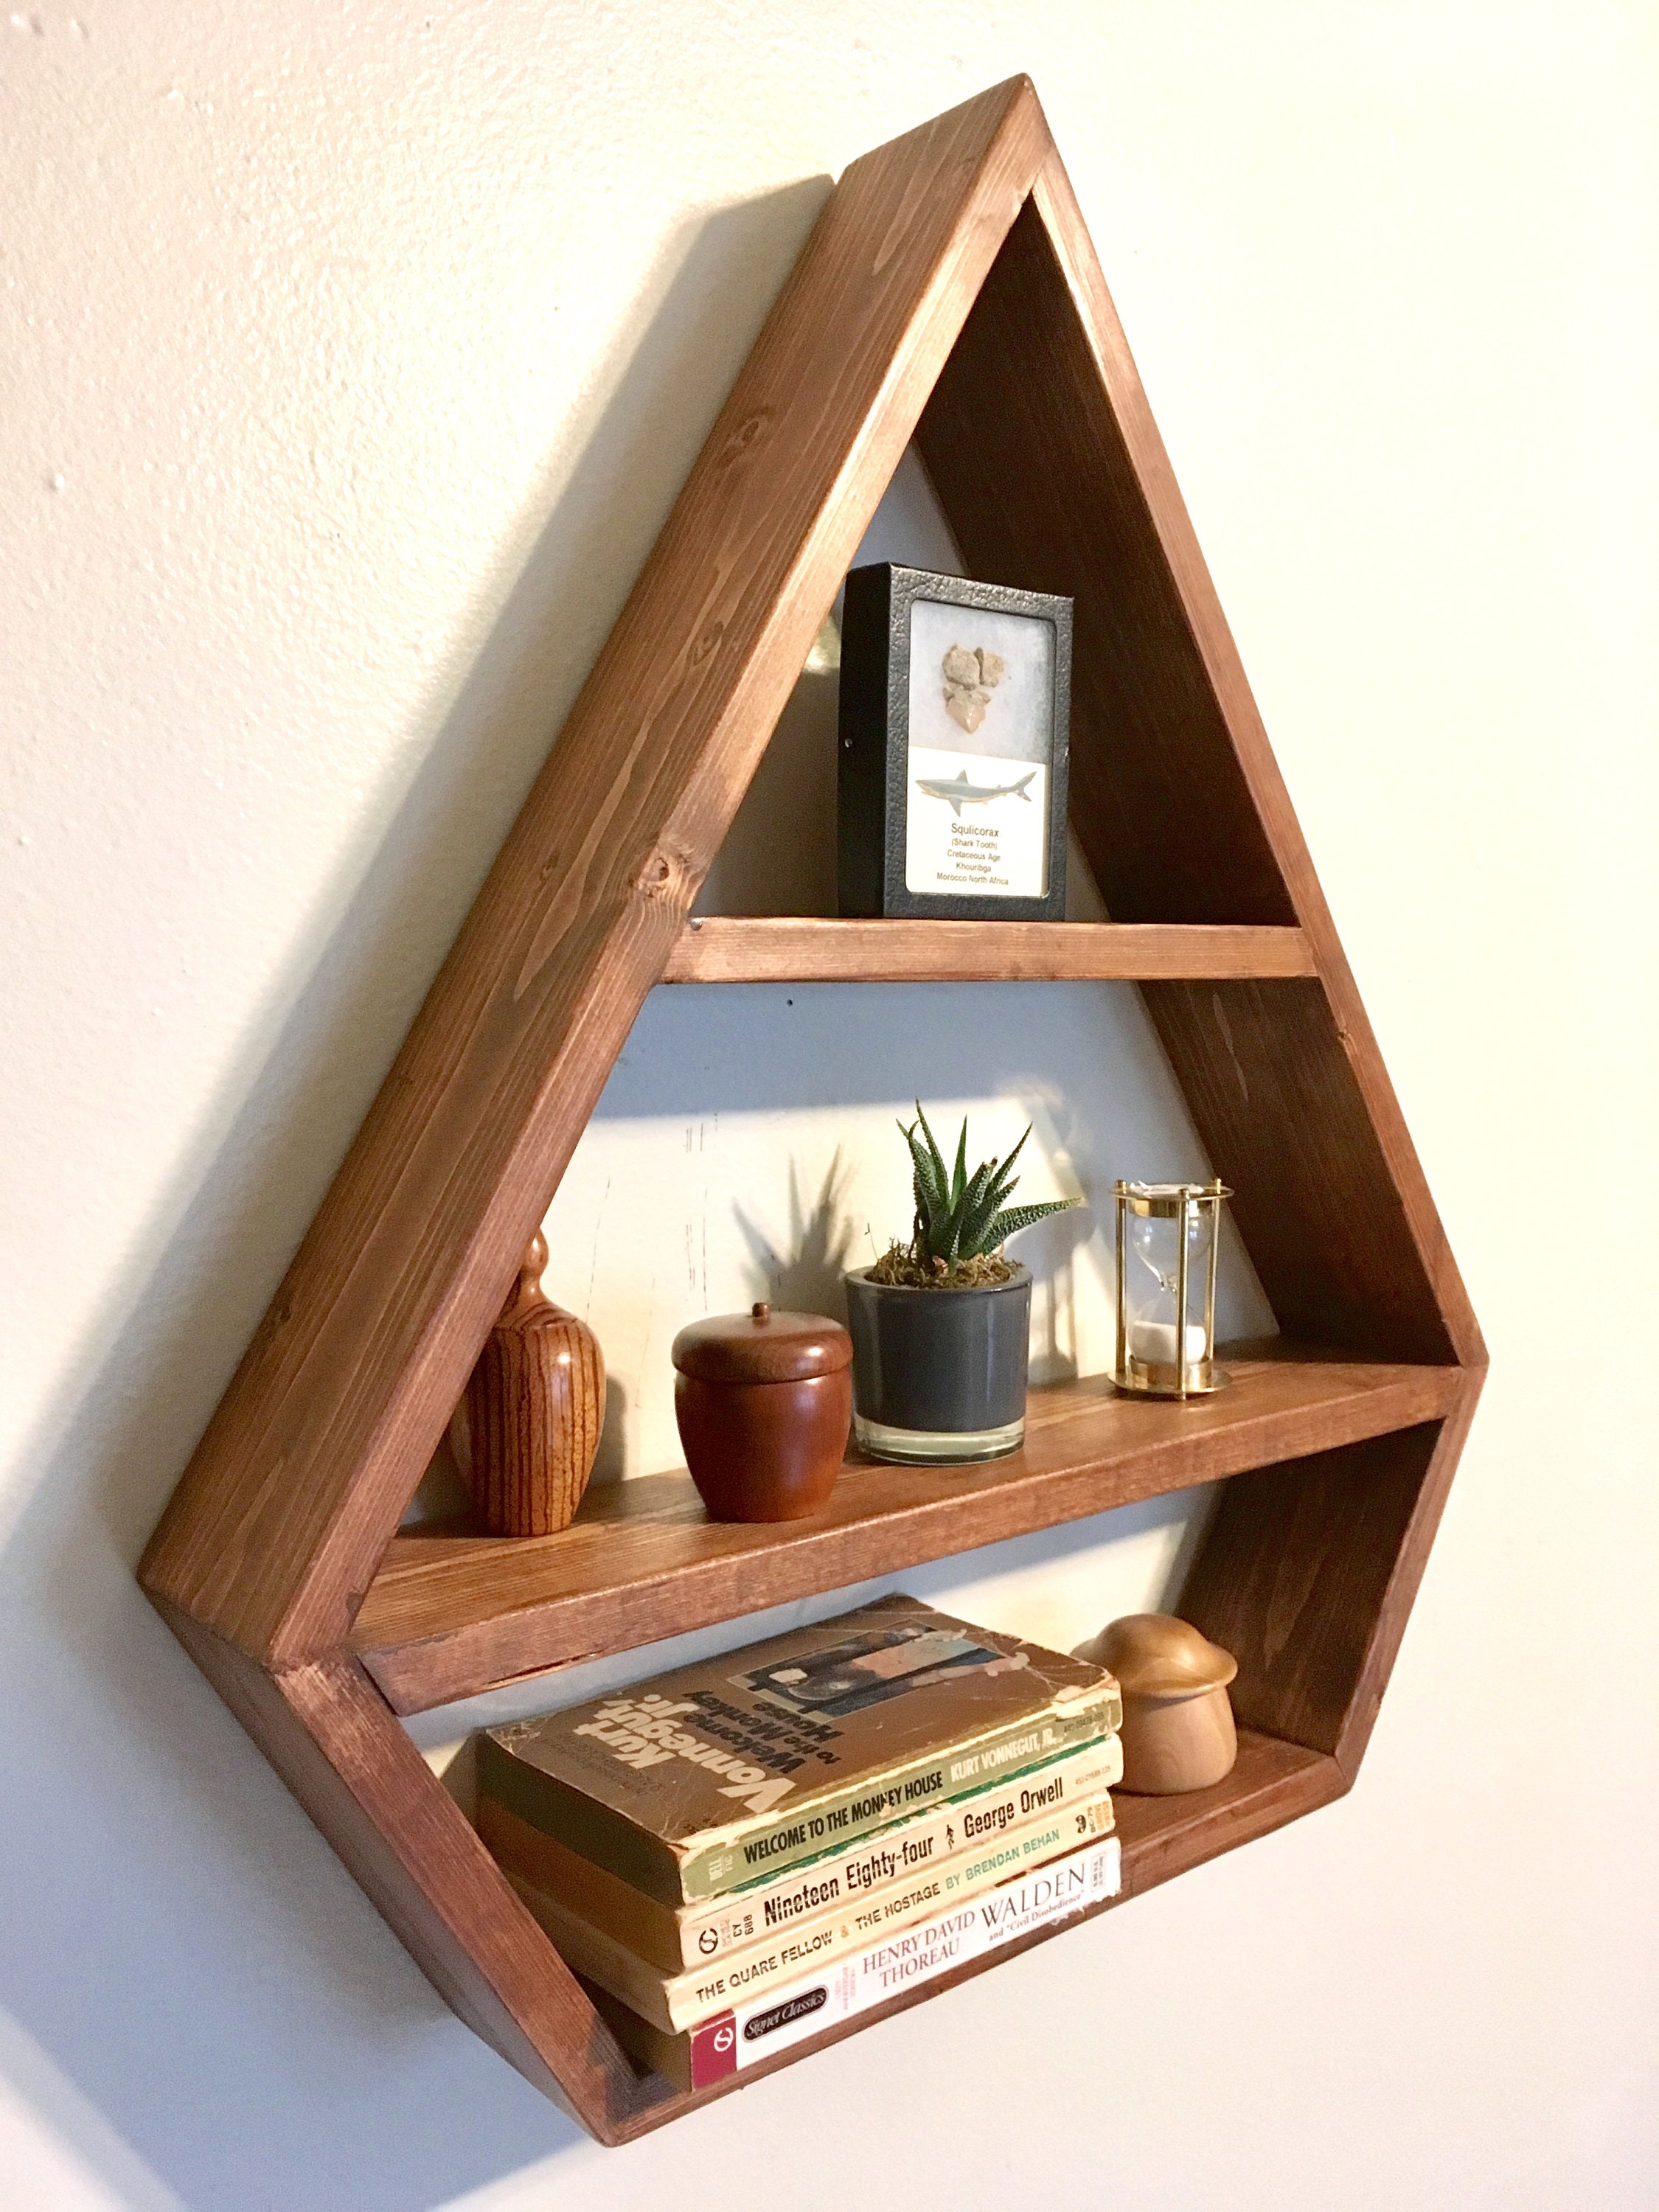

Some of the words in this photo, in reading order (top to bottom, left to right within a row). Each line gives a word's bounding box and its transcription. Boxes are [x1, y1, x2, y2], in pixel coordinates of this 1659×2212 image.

[947, 849, 986, 860] Cretaceous
[987, 852, 1001, 863] Age
[951, 838, 974, 847] (Shark
[976, 840, 998, 851] Tooth)
[936, 872, 967, 882] Morocco
[968, 874, 987, 883] North
[989, 877, 1009, 886] Africa
[956, 861, 992, 874] Khouribga
[681, 1690, 793, 1741] Monkey
[753, 1702, 845, 1742] House
[572, 1719, 677, 1770] Kurt
[683, 1713, 807, 1774] Welcome
[784, 1736, 820, 1755] the
[816, 1751, 842, 1764] to
[950, 1756, 980, 1782] KURT
[981, 1733, 1041, 1770] VONNEGUT,
[743, 1824, 807, 1864] WELCOME
[807, 1818, 825, 1839] TO
[827, 1807, 849, 1832] THE
[905, 1771, 943, 1801] HOUSE
[964, 1802, 1015, 1837] George
[1020, 1777, 1063, 1813] Orwell
[708, 1857, 723, 1881] DELL
[724, 1854, 734, 1872] FIC
[764, 1878, 840, 1927] Nineteen
[846, 1837, 933, 1890] Eighty-four
[696, 1979, 726, 2003] THE
[728, 1956, 778, 1988] QUARE
[781, 1930, 833, 1965] FELLOW
[841, 1925, 850, 1938] &
[855, 1909, 882, 1930] THE
[885, 1882, 941, 1918] HOSTAGE
[945, 1873, 961, 1890] BY
[965, 1847, 1020, 1880] BRENDAN
[1023, 1829, 1060, 1854] BEHAN
[981, 1863, 1085, 1927] WALDEN
[732, 1923, 742, 1938] CY
[742, 1914, 754, 1935] 688
[863, 1934, 922, 1974] HENRY
[925, 1910, 975, 1945] DAVID
[989, 1927, 1004, 1941] and
[1006, 1914, 1029, 1930] "Civil
[879, 1938, 960, 1987] THOREAU
[747, 2011, 781, 2037] Signet
[782, 1992, 825, 2020] Classics
